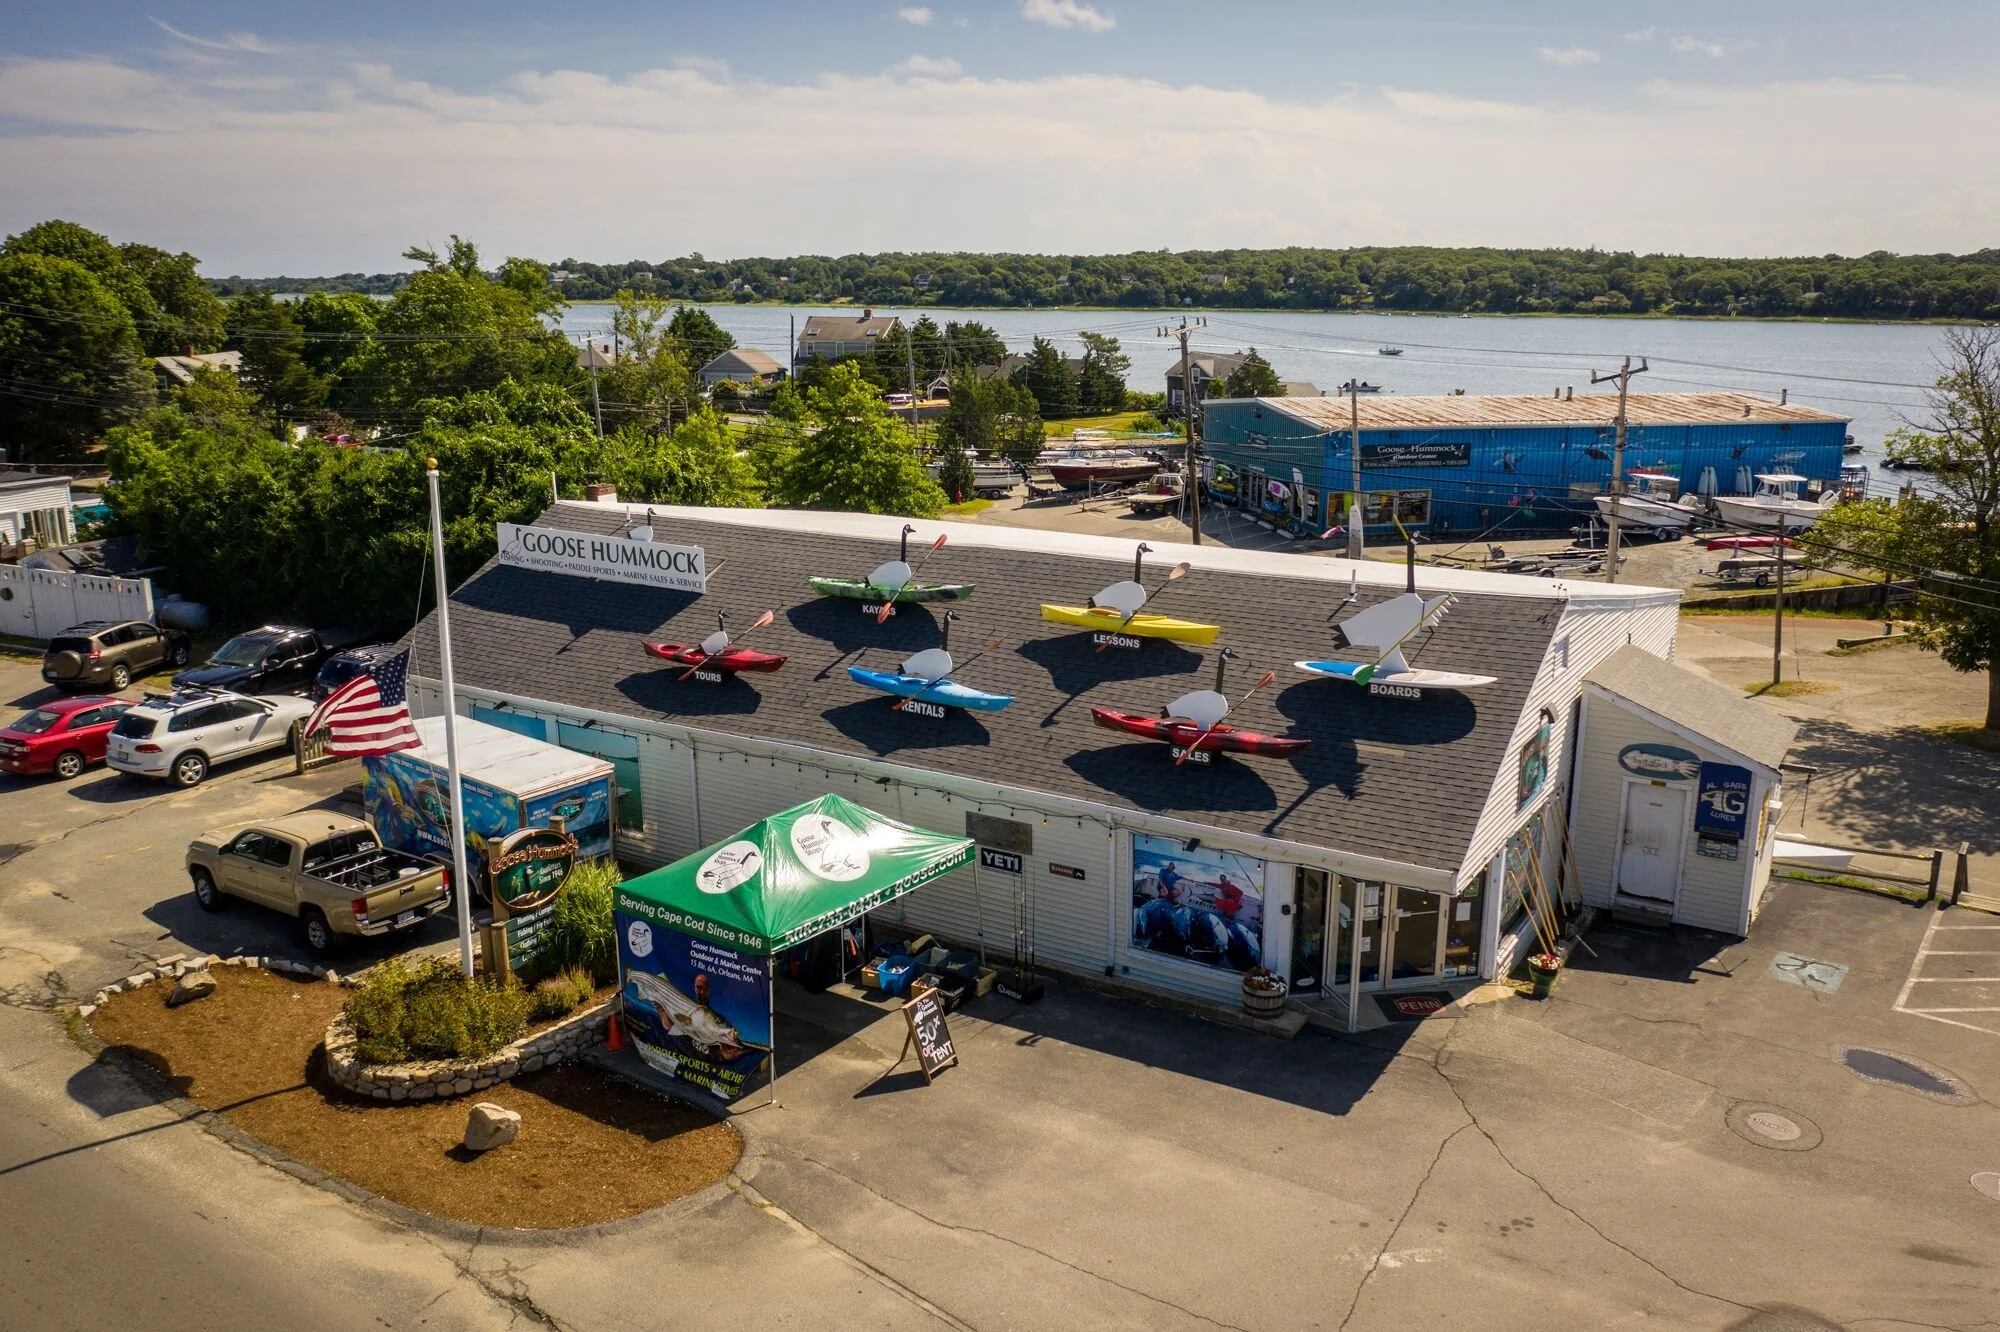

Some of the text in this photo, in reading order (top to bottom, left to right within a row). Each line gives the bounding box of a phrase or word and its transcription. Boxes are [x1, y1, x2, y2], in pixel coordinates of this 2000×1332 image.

[1377, 444, 1457, 453] Goose Hummock
[522, 531, 700, 575] GOOSE HUMMOCK
[500, 553, 703, 590] FISHING SHOOTING PADDLE SPORTS MARINE SALES & SERVICE
[862, 604, 896, 616] KAYS
[694, 670, 723, 683] TOURS
[1369, 683, 1421, 698] BOARDS
[901, 700, 945, 719] RENTALS
[1706, 781, 1747, 790] AL GAGS
[1710, 810, 1736, 821] LURES
[488, 832, 579, 875] Goose Hummock
[982, 850, 1020, 871] YETI
[538, 867, 564, 885] Since 1946
[894, 848, 967, 897] goose.com
[619, 894, 762, 949] Serving Cape Cod Since 1946
[691, 940, 738, 960] Goose Hummock
[690, 950, 714, 962] Outdoor
[720, 959, 741, 973] Marine
[742, 965, 762, 976] Center
[742, 974, 754, 984] MA
[1398, 1000, 1441, 1010] PENN
[917, 1015, 941, 1046] 50%
[922, 1042, 936, 1058] OFF
[679, 1054, 710, 1073] SPORTS
